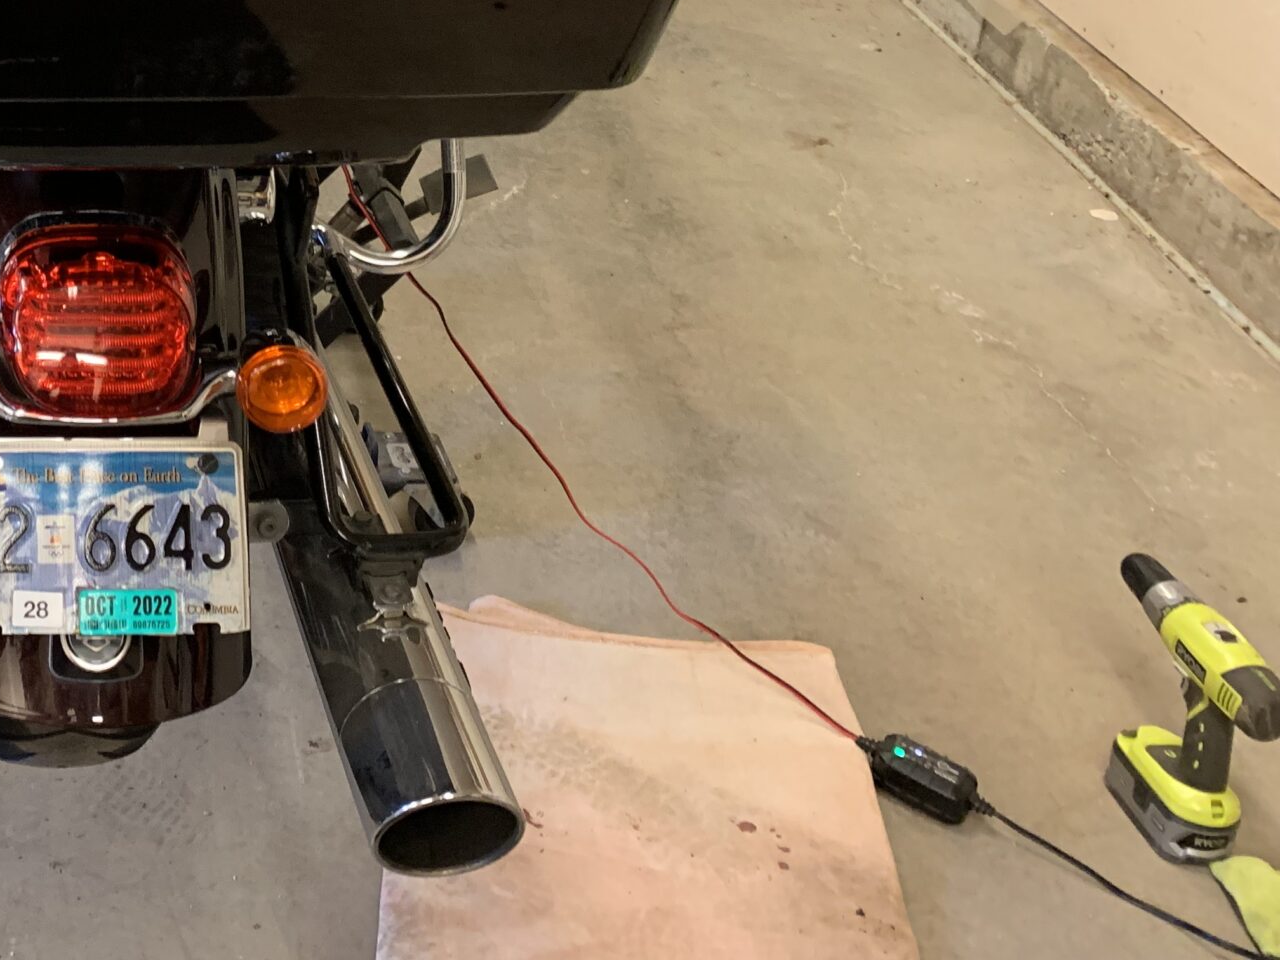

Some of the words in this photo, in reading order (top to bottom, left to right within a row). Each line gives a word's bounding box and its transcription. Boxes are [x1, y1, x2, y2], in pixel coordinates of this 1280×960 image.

[122, 472, 138, 484] on
[144, 466, 182, 484] Earth
[83, 503, 232, 573] 6643
[23, 600, 49, 619] 28
[85, 595, 116, 617] OCT
[132, 595, 173, 616] 2022
